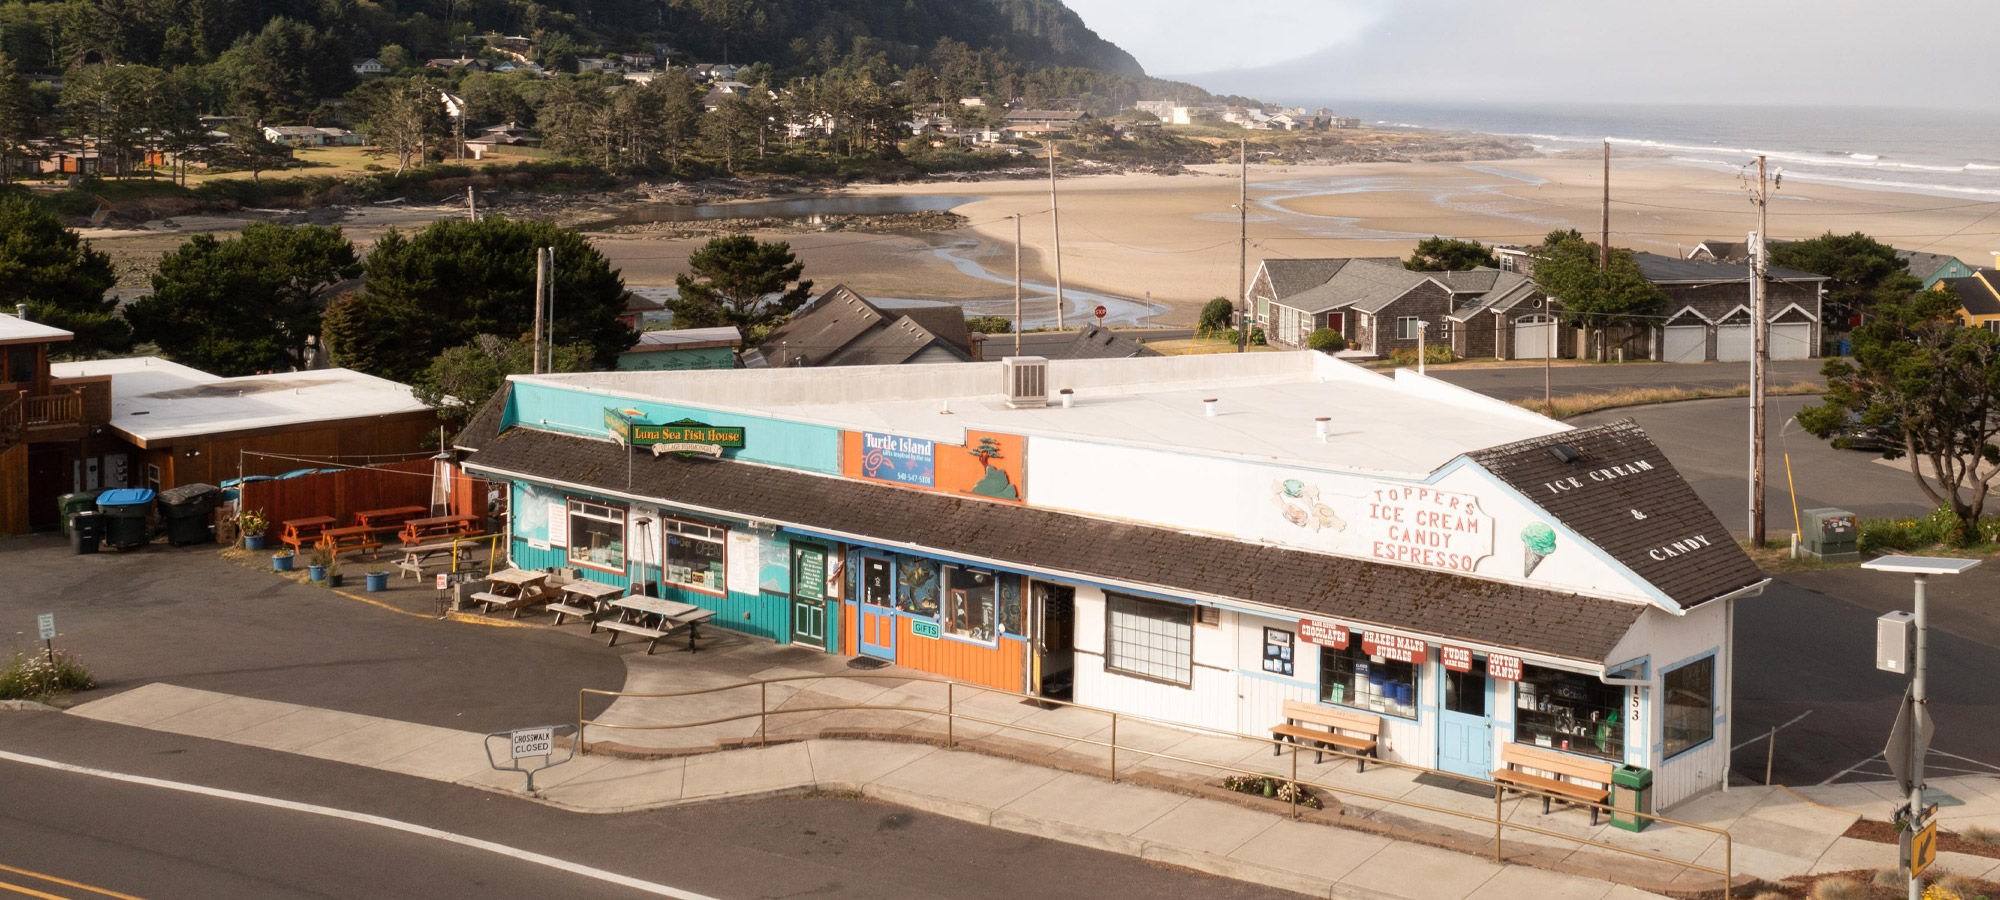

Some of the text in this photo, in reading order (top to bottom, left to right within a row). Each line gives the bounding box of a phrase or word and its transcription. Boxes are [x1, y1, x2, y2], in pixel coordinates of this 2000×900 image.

[635, 428, 659, 439] Luna
[662, 429, 681, 440] Sea
[684, 429, 705, 441] Fish
[708, 430, 739, 441] House
[865, 433, 931, 456] Turtle Island
[1545, 460, 1654, 494] ICE CREAM
[1374, 487, 1475, 516] TOPPERS
[1369, 503, 1478, 534] ICE CREAM
[1631, 509, 1647, 520] &
[1388, 525, 1452, 549] CANDY
[695, 541, 721, 557] OPEN
[1373, 541, 1472, 571] ESPRESSO
[1650, 535, 1711, 561] CANDY
[915, 624, 937, 635] GIFTS
[1301, 624, 1346, 643] CHOCOLATES
[1364, 631, 1424, 652] SHAKES MALTS
[1376, 645, 1412, 662] SUNDAES
[1443, 646, 1469, 662] FUDGE
[1489, 653, 1519, 669] COTTON
[1444, 659, 1457, 667] MADE
[1489, 665, 1520, 680] CANDY
[514, 733, 550, 744] CROSSWALK
[515, 743, 549, 754] CLOSED
